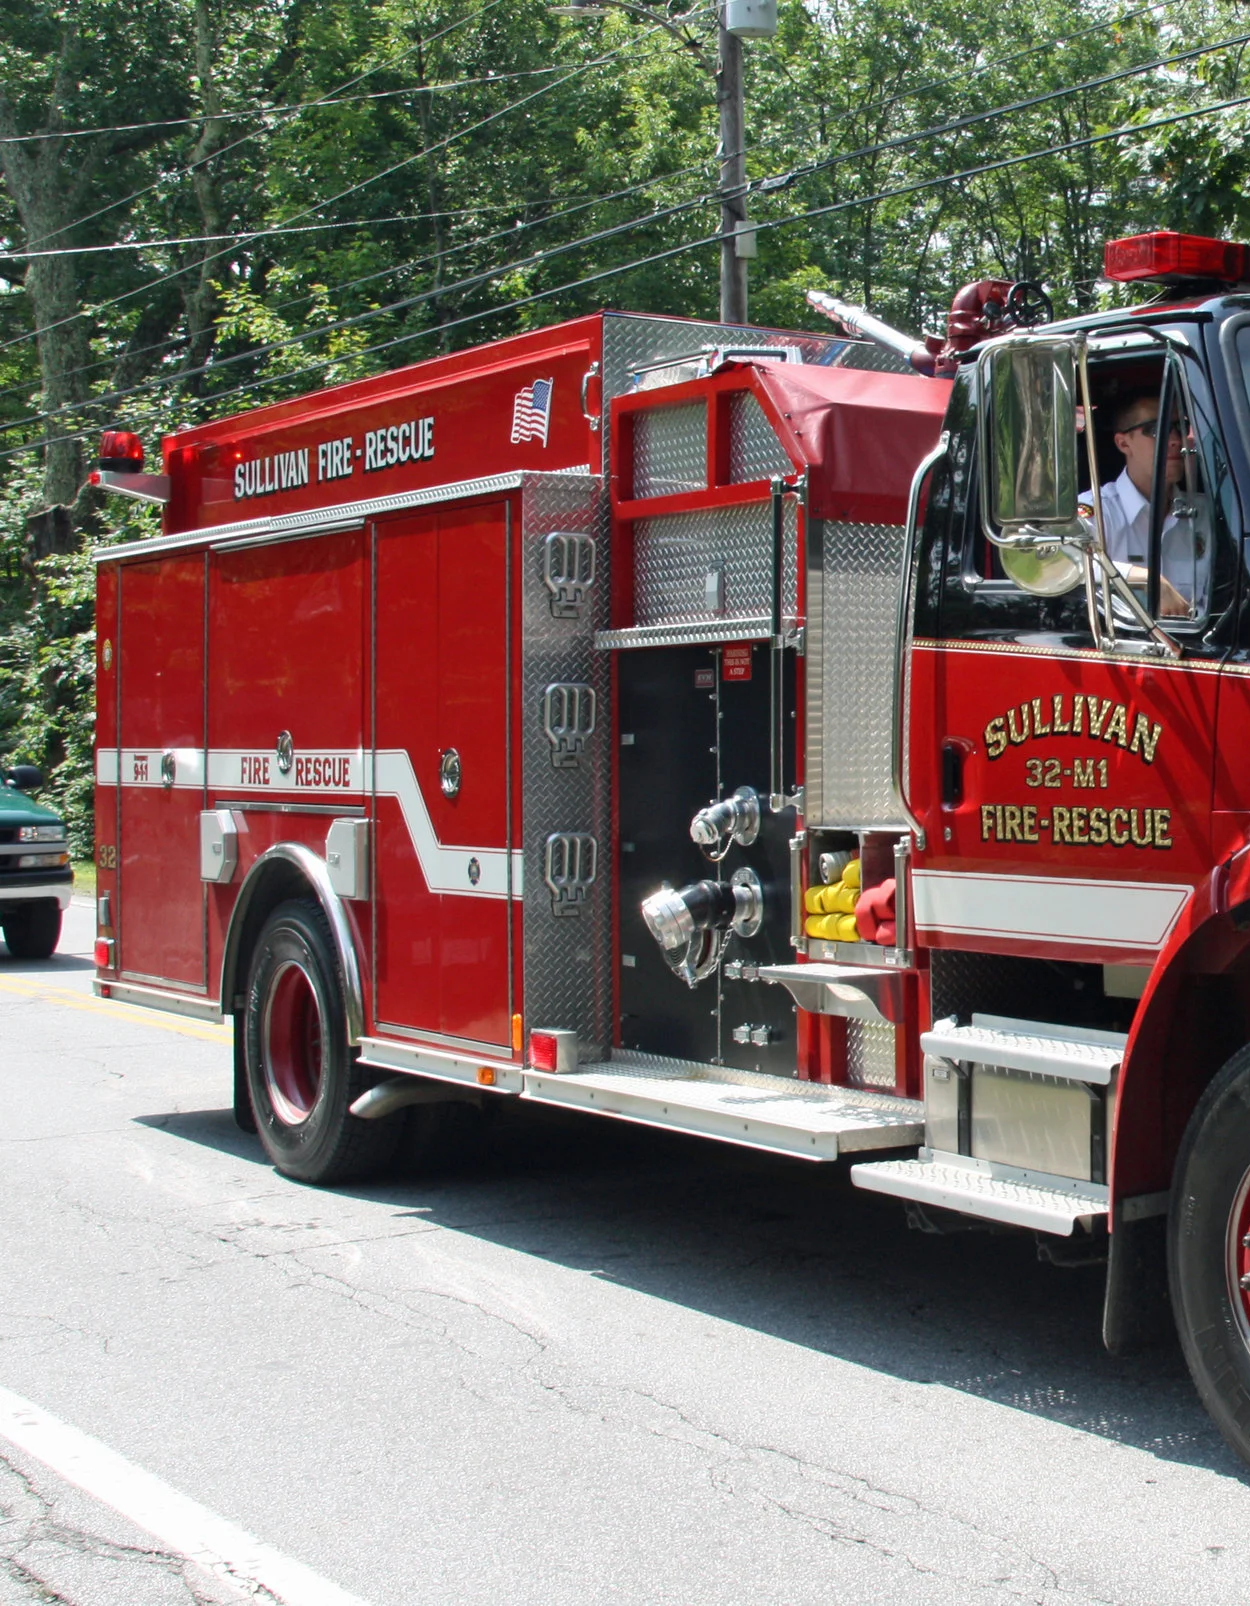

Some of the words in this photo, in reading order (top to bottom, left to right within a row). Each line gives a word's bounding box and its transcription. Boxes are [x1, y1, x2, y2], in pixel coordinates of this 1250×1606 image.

[234, 447, 309, 499] SULLIVAN
[984, 694, 1162, 763] SULLIVAN
[241, 756, 270, 785] FIRE
[295, 757, 350, 787] RESCUE
[1025, 757, 1108, 788] 32-M1
[99, 844, 117, 869] 32
